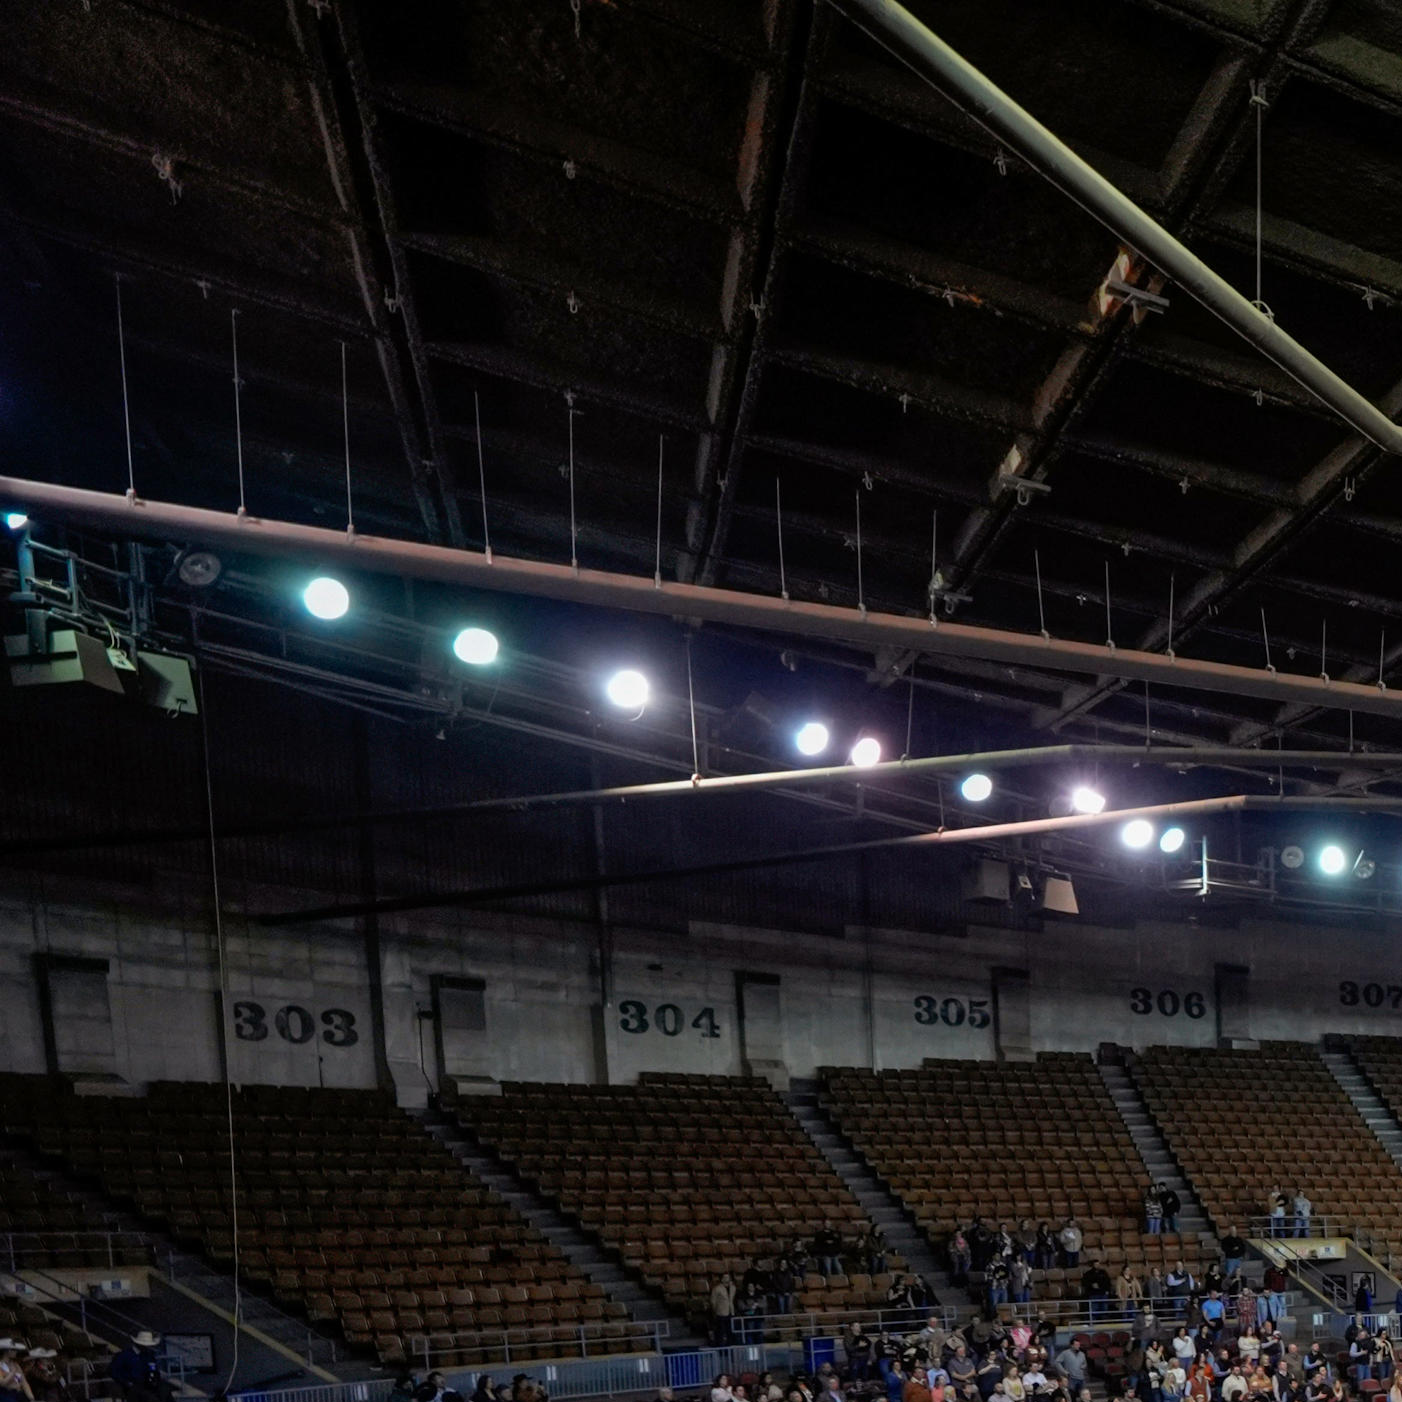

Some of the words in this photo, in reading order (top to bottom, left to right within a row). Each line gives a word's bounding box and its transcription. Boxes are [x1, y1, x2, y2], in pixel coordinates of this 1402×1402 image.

[619, 1000, 721, 1038] 304
[914, 995, 991, 1029] 305
[1130, 986, 1207, 1019] 306
[233, 1001, 359, 1047] 303
